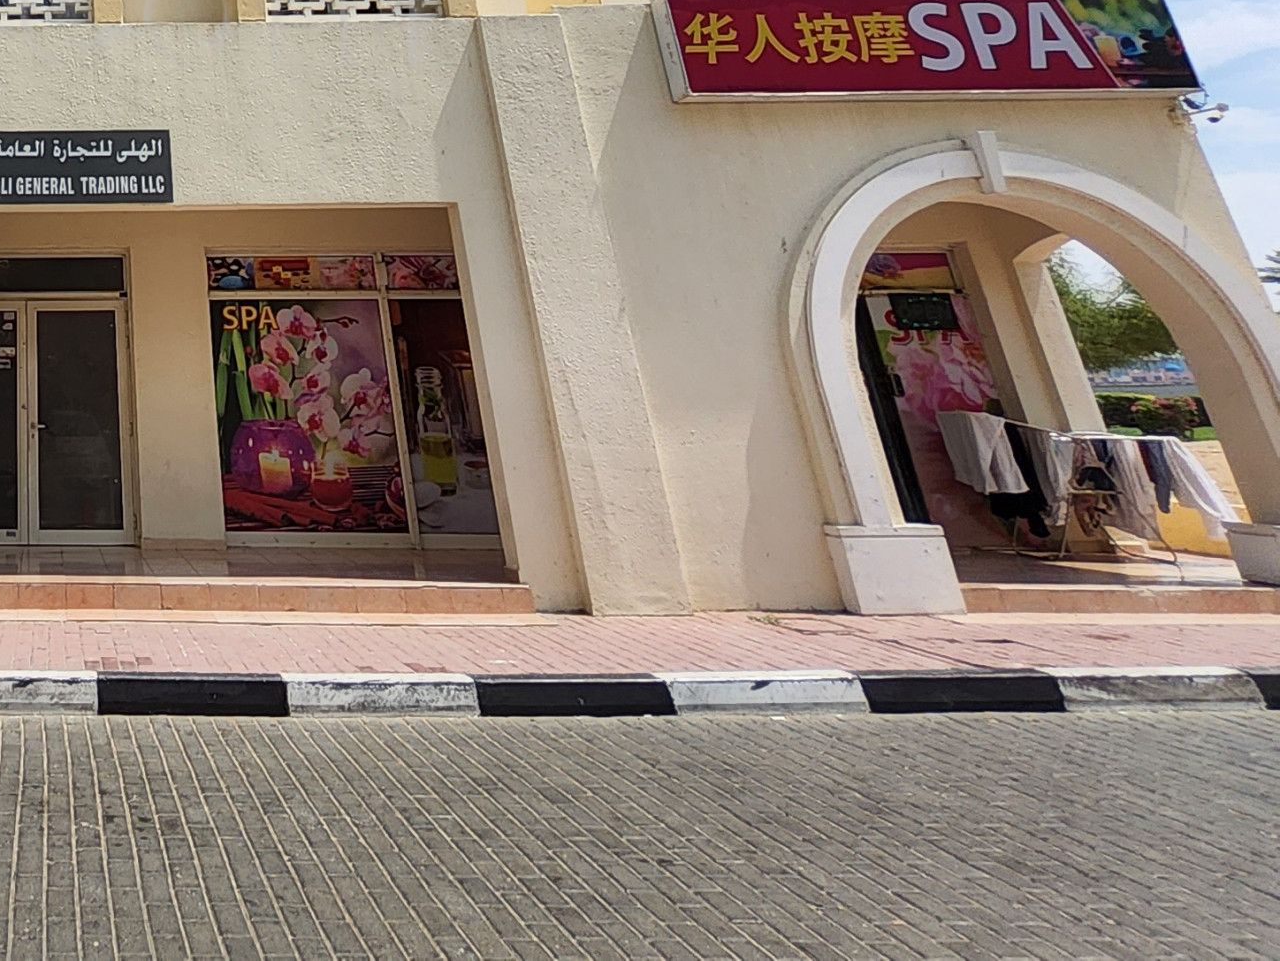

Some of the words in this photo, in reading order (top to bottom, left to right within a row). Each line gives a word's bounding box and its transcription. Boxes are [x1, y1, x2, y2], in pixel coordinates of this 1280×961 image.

[684, 12, 916, 64] 华人按摩
[907, 2, 1093, 71] SPA
[52, 139, 113, 163] للتجارة
[16, 176, 74, 194] GENERAL
[80, 175, 138, 194] TRADING
[141, 175, 165, 193] LLC
[222, 305, 280, 331] SPA
